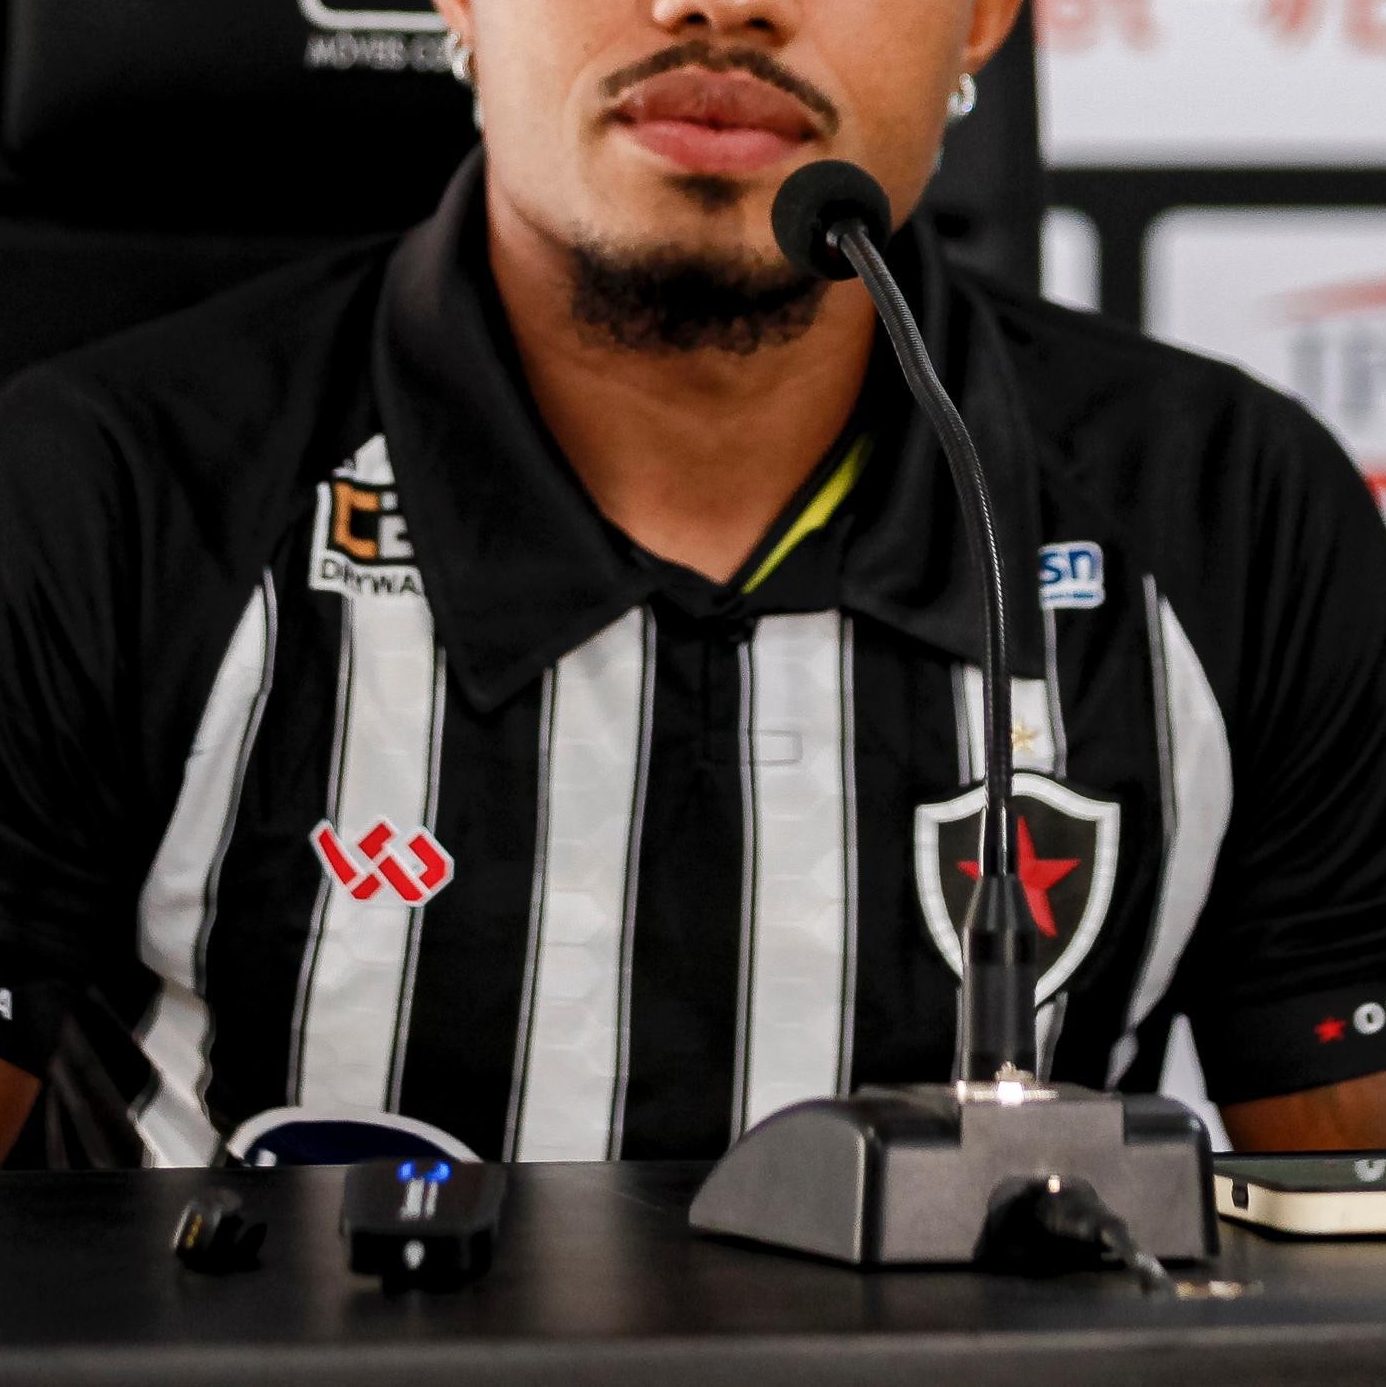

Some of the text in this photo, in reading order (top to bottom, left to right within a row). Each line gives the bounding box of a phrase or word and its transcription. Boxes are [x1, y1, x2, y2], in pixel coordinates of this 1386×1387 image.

[320, 559, 419, 595] DRYWA
[1037, 548, 1098, 585] sn
[1353, 1001, 1386, 1035] O
